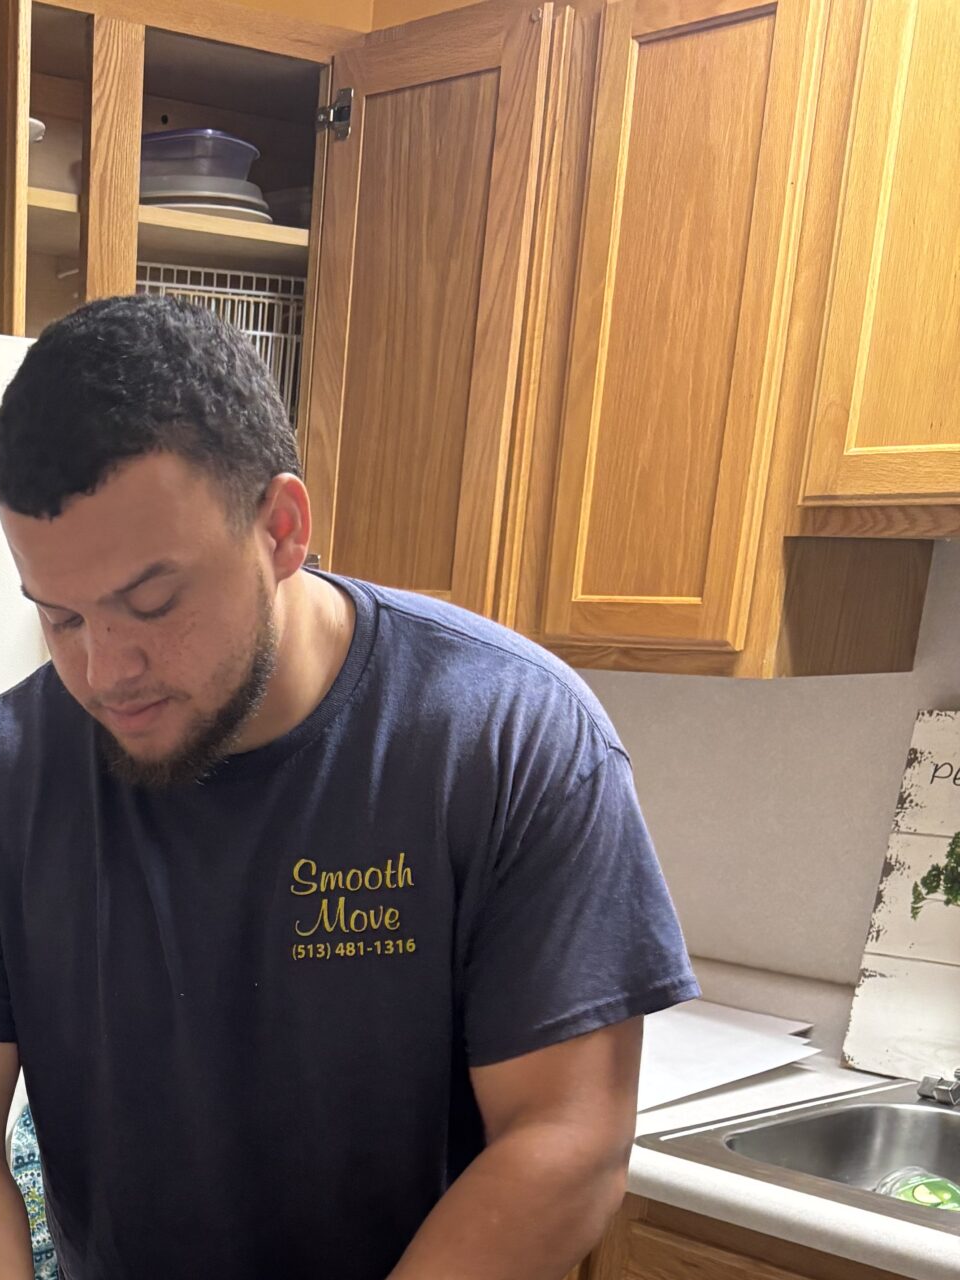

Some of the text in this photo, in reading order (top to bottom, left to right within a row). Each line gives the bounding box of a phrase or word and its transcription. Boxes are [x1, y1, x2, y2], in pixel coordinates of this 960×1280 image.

[290, 852, 414, 896] Smooth
[295, 896, 400, 937] Move
[292, 938, 416, 960] (513) 481-1316
